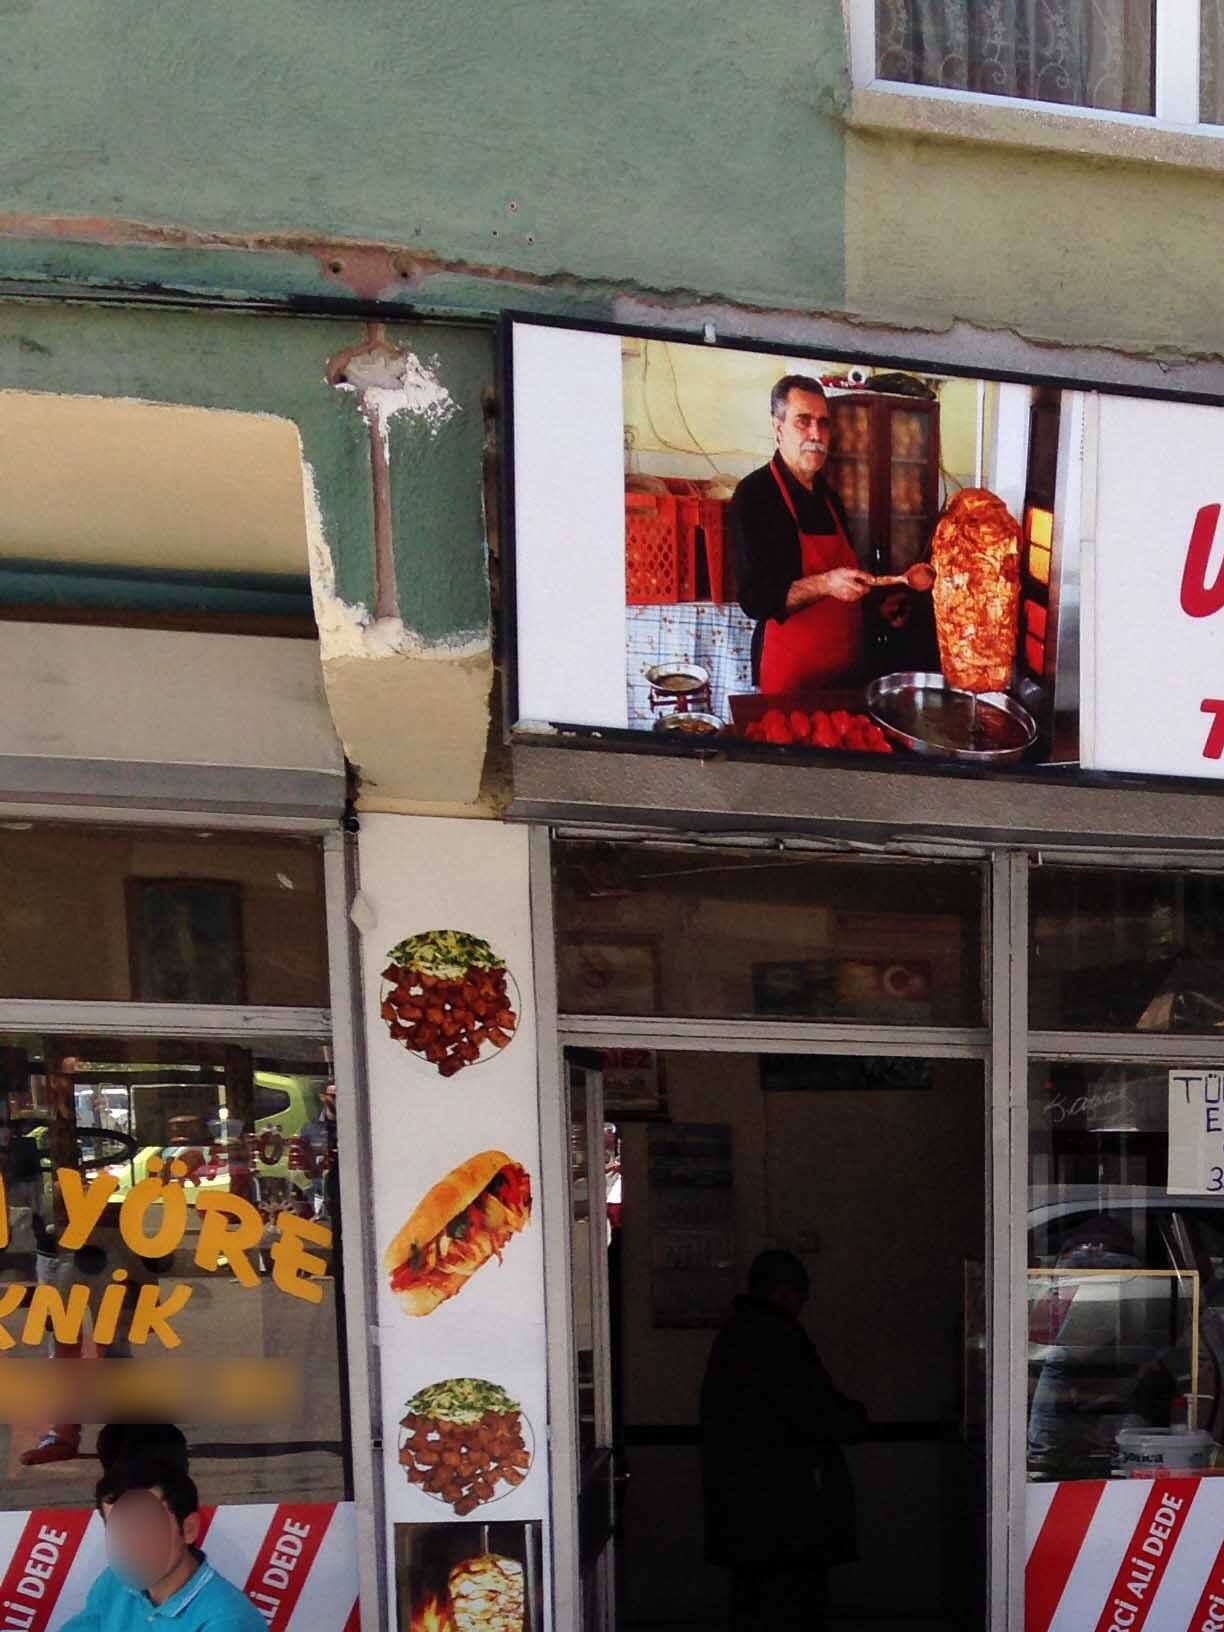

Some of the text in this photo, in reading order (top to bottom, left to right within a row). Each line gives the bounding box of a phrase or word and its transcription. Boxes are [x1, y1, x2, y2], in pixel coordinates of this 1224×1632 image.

[57, 1155, 334, 1305] YÖRE
[16, 1525, 69, 1600] DEDE
[250, 1518, 312, 1626] Lİ DEDE
[1126, 1555, 1156, 1600] ALİ
[1142, 1492, 1184, 1557] DEDE
